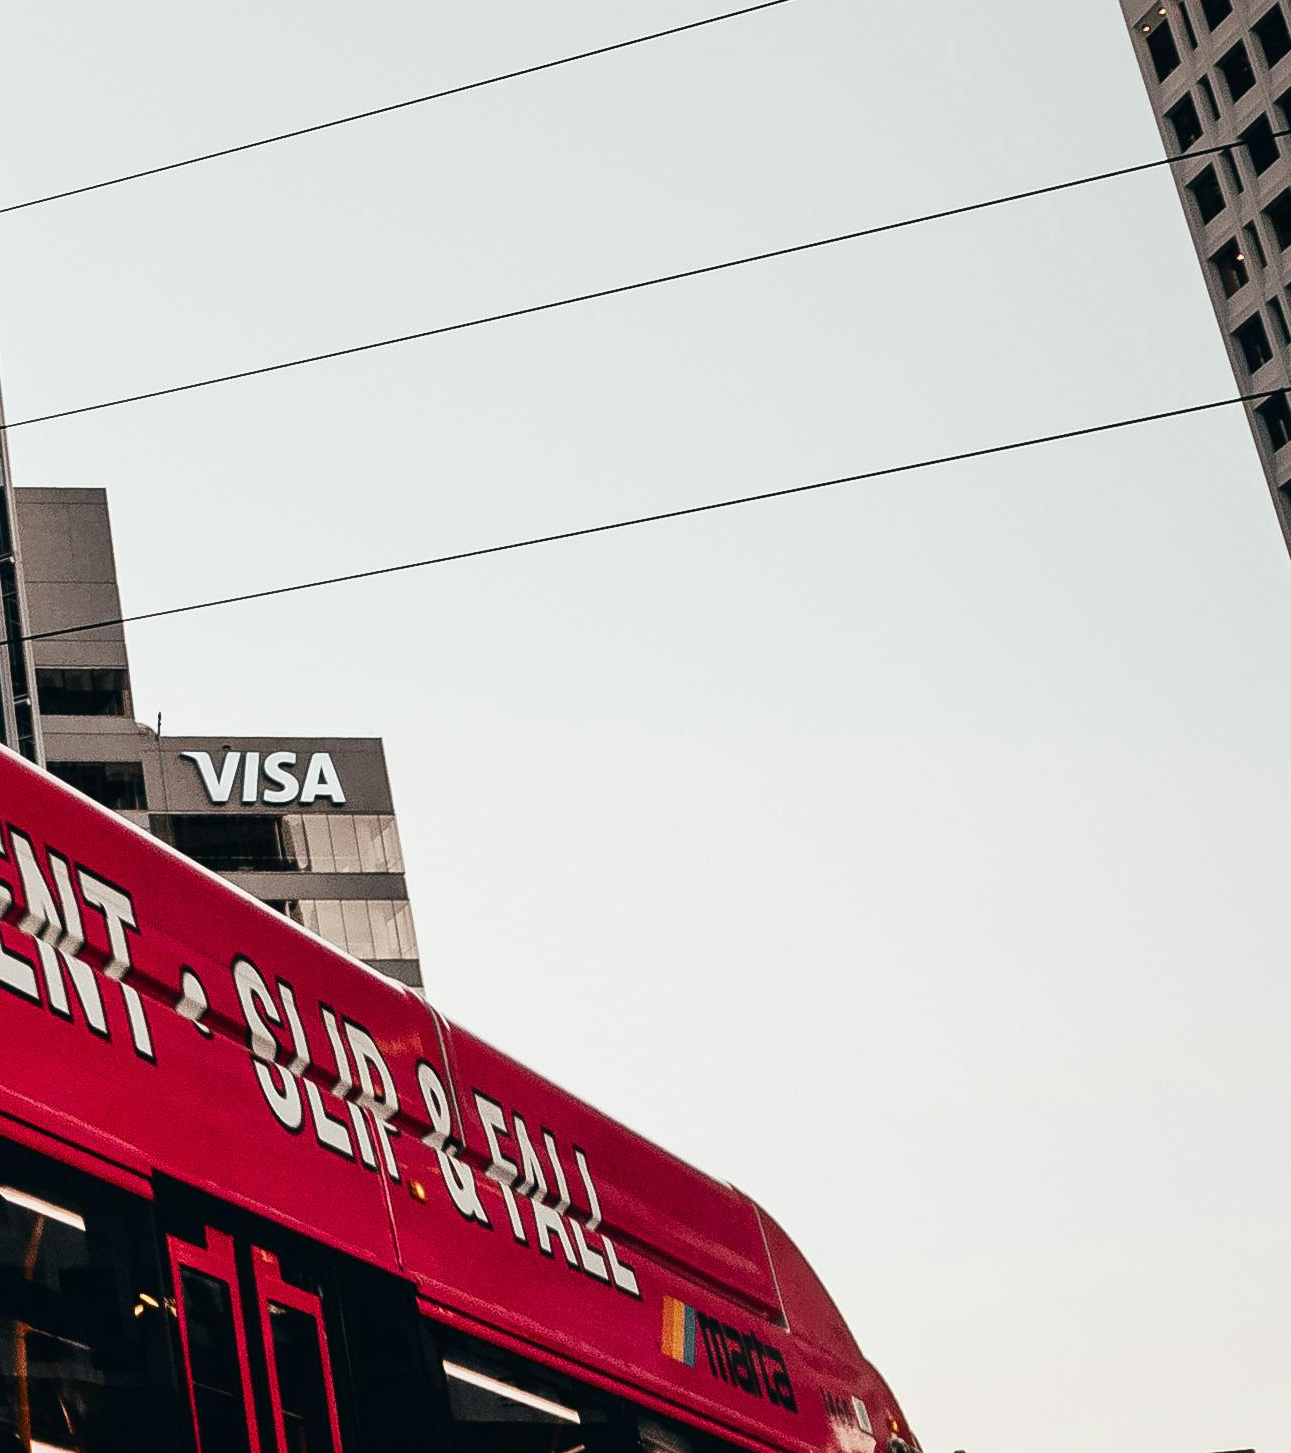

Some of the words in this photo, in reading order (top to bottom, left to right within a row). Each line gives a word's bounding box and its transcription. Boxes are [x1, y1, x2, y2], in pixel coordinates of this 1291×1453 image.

[180, 751, 347, 804] VISA
[231, 955, 402, 1184] SLIP
[416, 1059, 493, 1231] &
[472, 1089, 643, 1301] FALL
[697, 1311, 798, 1414] marta
